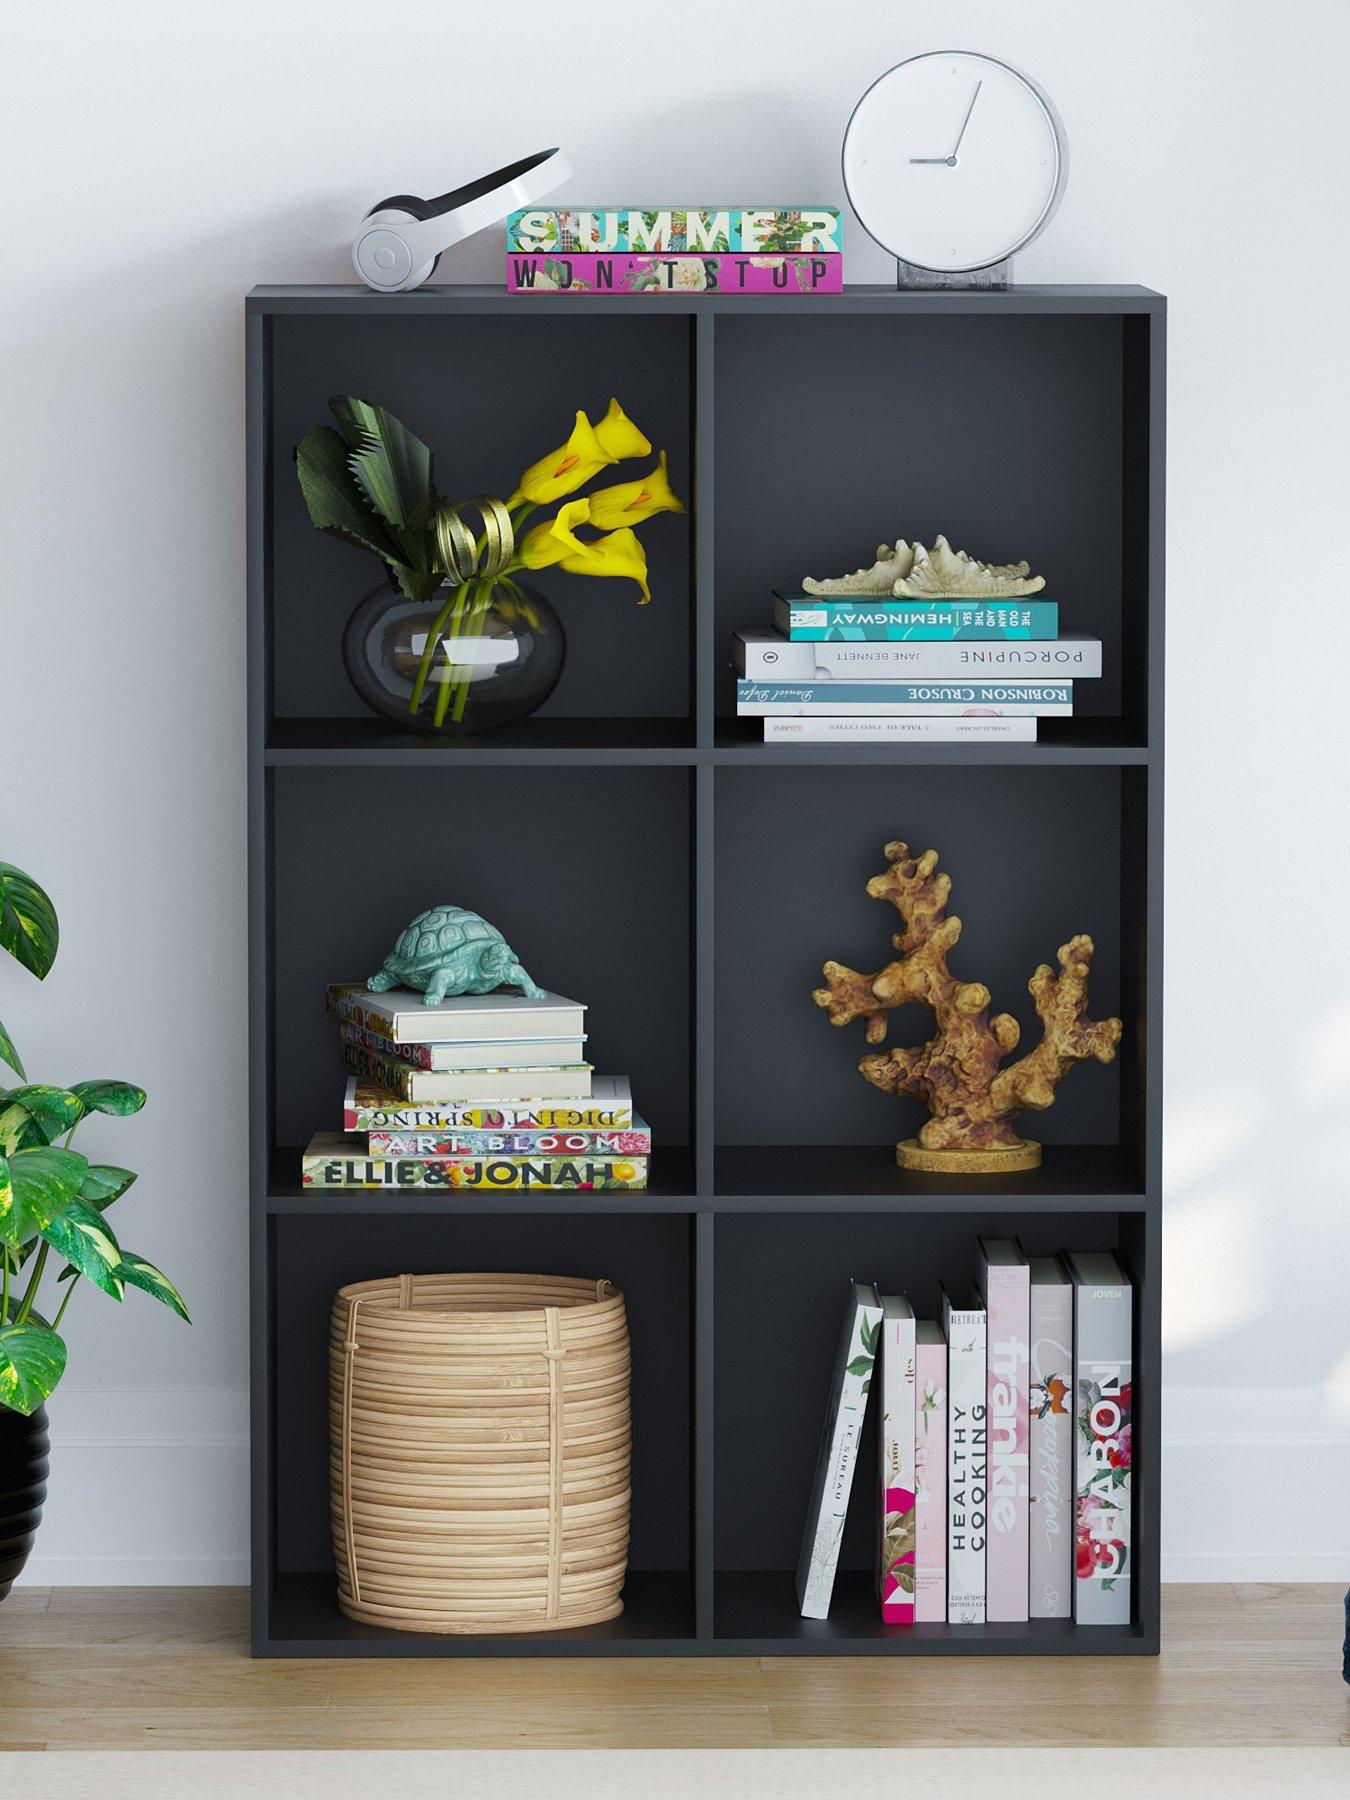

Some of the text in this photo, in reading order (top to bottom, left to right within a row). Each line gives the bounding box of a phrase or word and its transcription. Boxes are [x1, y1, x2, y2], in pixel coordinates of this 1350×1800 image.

[519, 211, 841, 252] SUMMER
[703, 258, 828, 289] STOP
[832, 612, 951, 624] HEMINGWAY
[963, 610, 972, 627] SEA
[974, 610, 983, 627] THE
[986, 610, 995, 627] AND
[998, 610, 1006, 627] MAN
[1010, 610, 1018, 627] OLD
[1022, 610, 1031, 627] THE
[836, 652, 921, 661] JANE BENNETT
[960, 651, 1083, 663] PORCUPINE
[770, 690, 813, 702] Daniel
[908, 688, 1067, 701] ROBINSON CRUSOE
[372, 1111, 615, 1127] DIG INTO SPRING
[385, 1135, 620, 1152] ART BLOOM
[325, 1161, 415, 1185] ELLIE
[466, 1161, 613, 1185] JONAH
[1090, 1289, 1122, 1299] JOVEN
[991, 1335, 1029, 1533] frankie
[835, 1446, 850, 1500] SUREAU
[952, 1406, 967, 1550] HEALTHY
[971, 1404, 986, 1552] COOKING
[1090, 1365, 1122, 1576] CHABON
